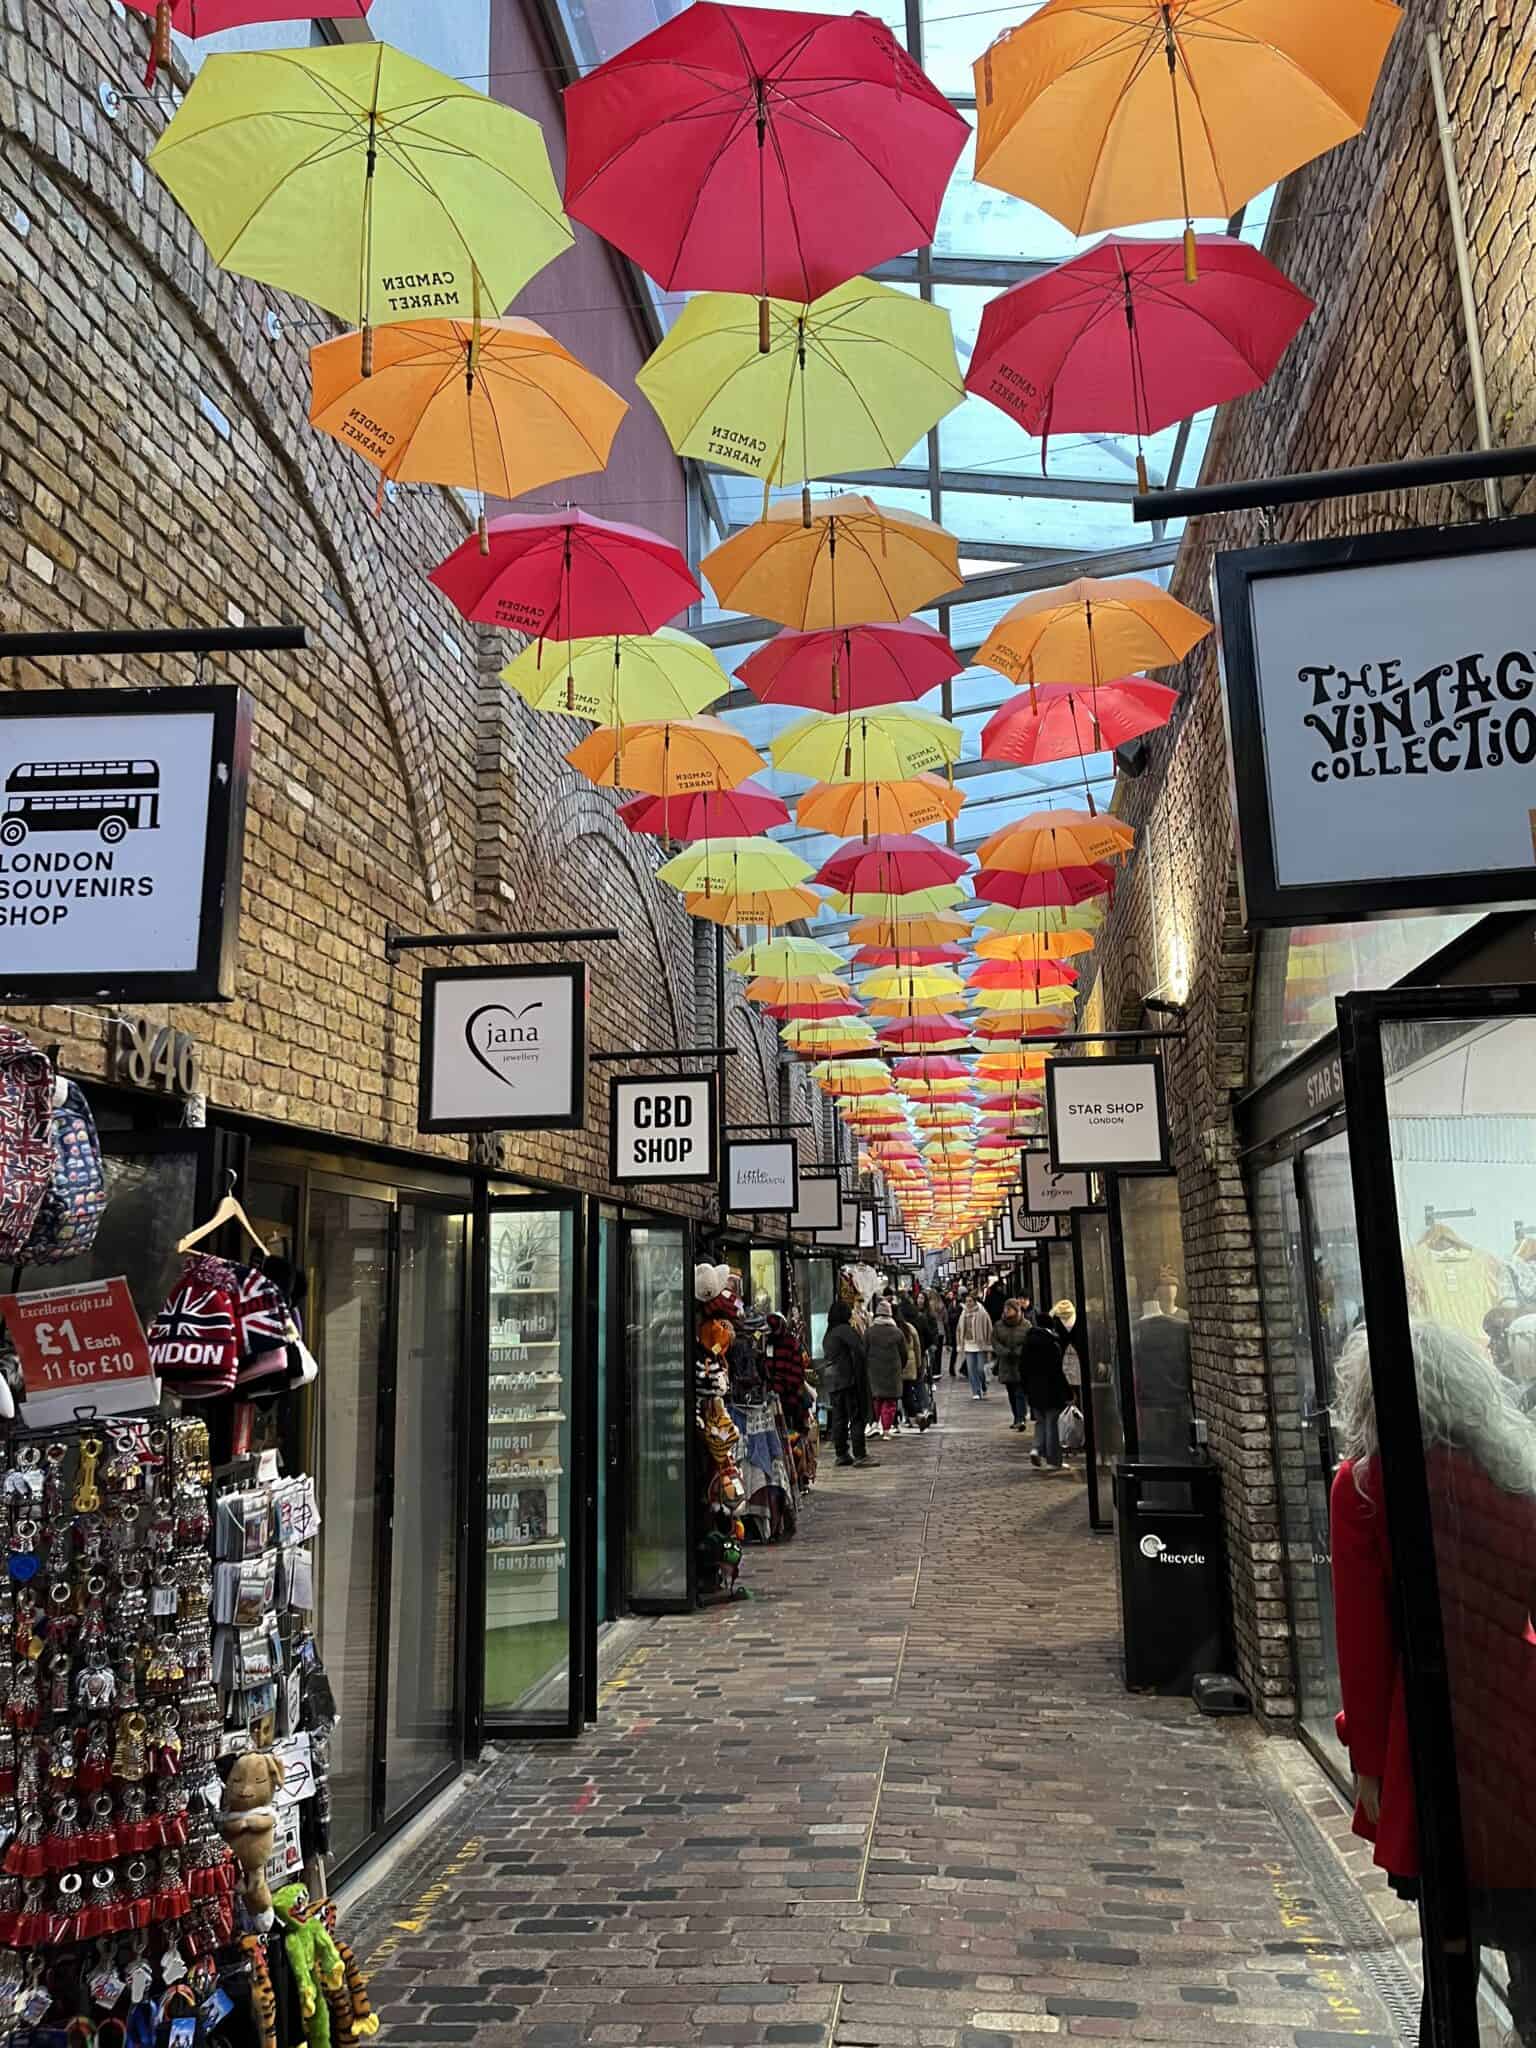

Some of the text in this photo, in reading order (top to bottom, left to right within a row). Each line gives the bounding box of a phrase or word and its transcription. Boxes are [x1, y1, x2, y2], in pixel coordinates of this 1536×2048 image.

[1298, 660, 1403, 706] THE
[0, 851, 113, 873] LONDON
[487, 1022, 539, 1049] jana
[503, 1052, 539, 1063] jewellery
[1307, 1067, 1332, 1107] STAR
[634, 1096, 692, 1128] CBD
[1068, 1103, 1144, 1115] STAR SHOP
[1089, 1117, 1124, 1125] LONDON
[634, 1138, 692, 1163] SHOP
[20, 1296, 113, 1319] Excellent Gift Ltd
[35, 1319, 121, 1356] £1 Each
[42, 1352, 134, 1381] 11 for £10
[1160, 1552, 1205, 1565] Recycle
